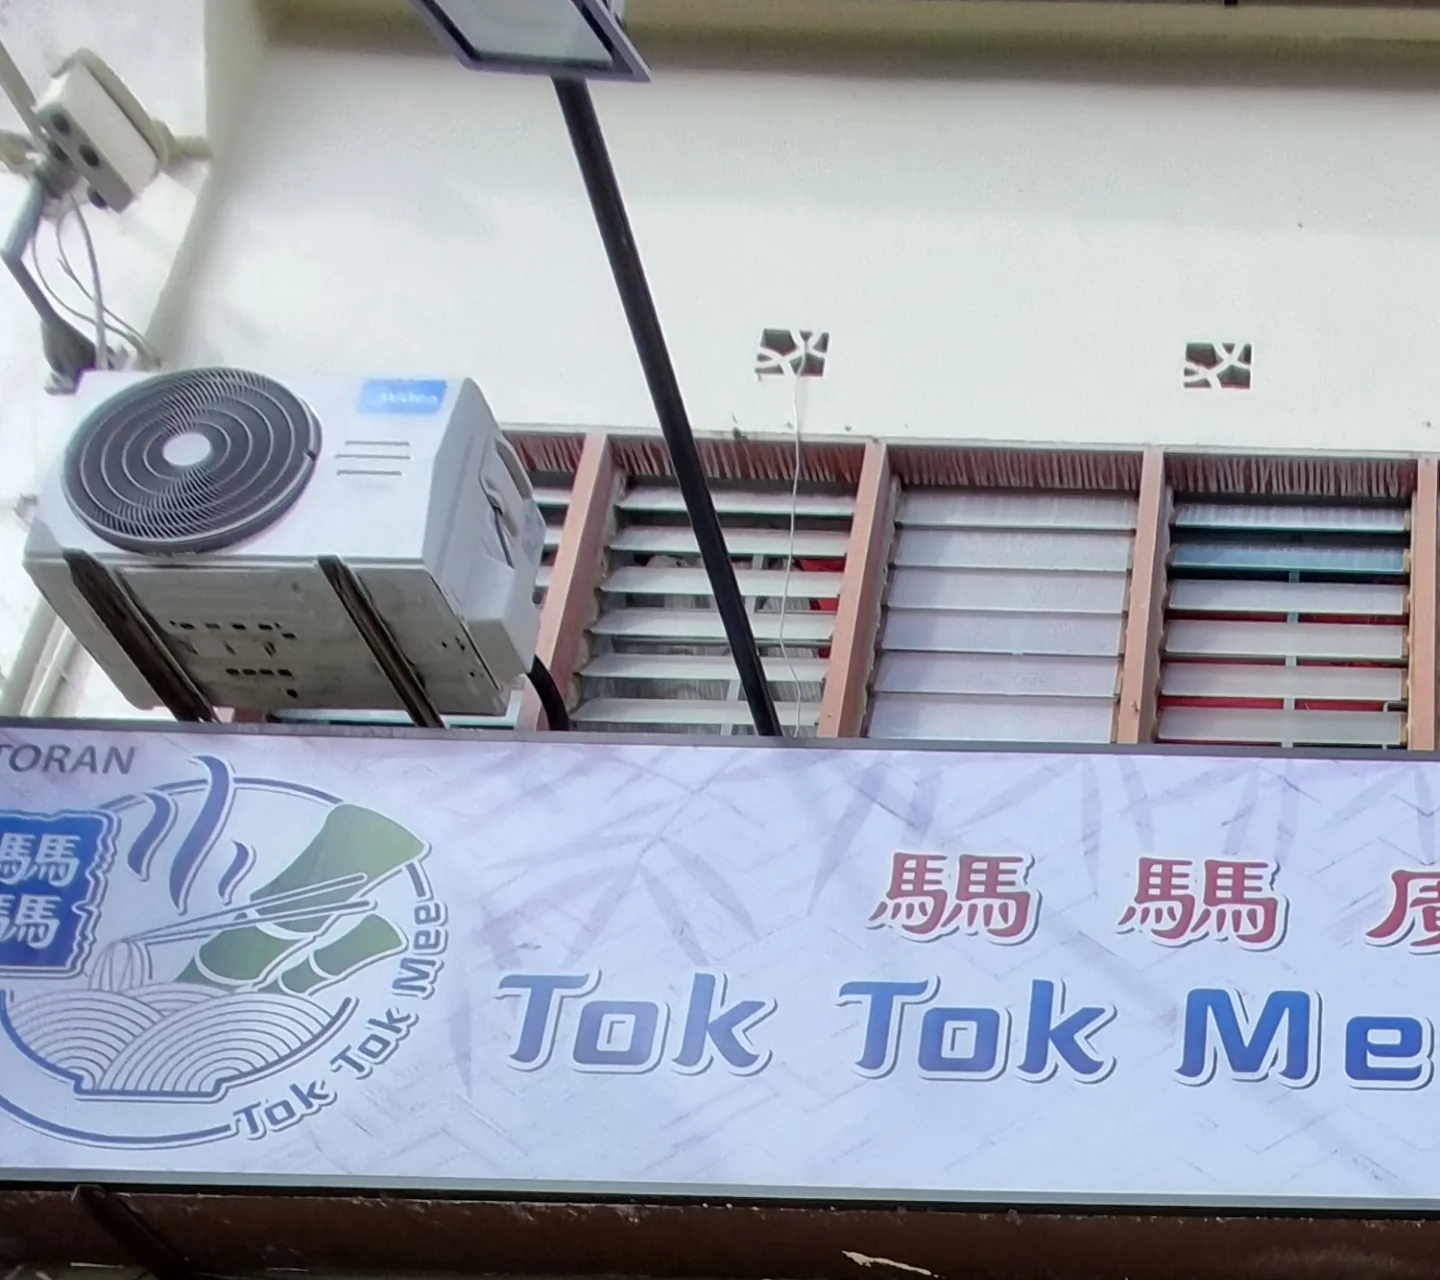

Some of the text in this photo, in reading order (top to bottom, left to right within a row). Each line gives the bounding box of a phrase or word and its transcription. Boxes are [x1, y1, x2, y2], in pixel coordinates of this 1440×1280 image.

[233, 902, 443, 1135] Tok Tok Mee
[498, 972, 772, 1070] Tok
[837, 978, 1110, 1077] Tok
